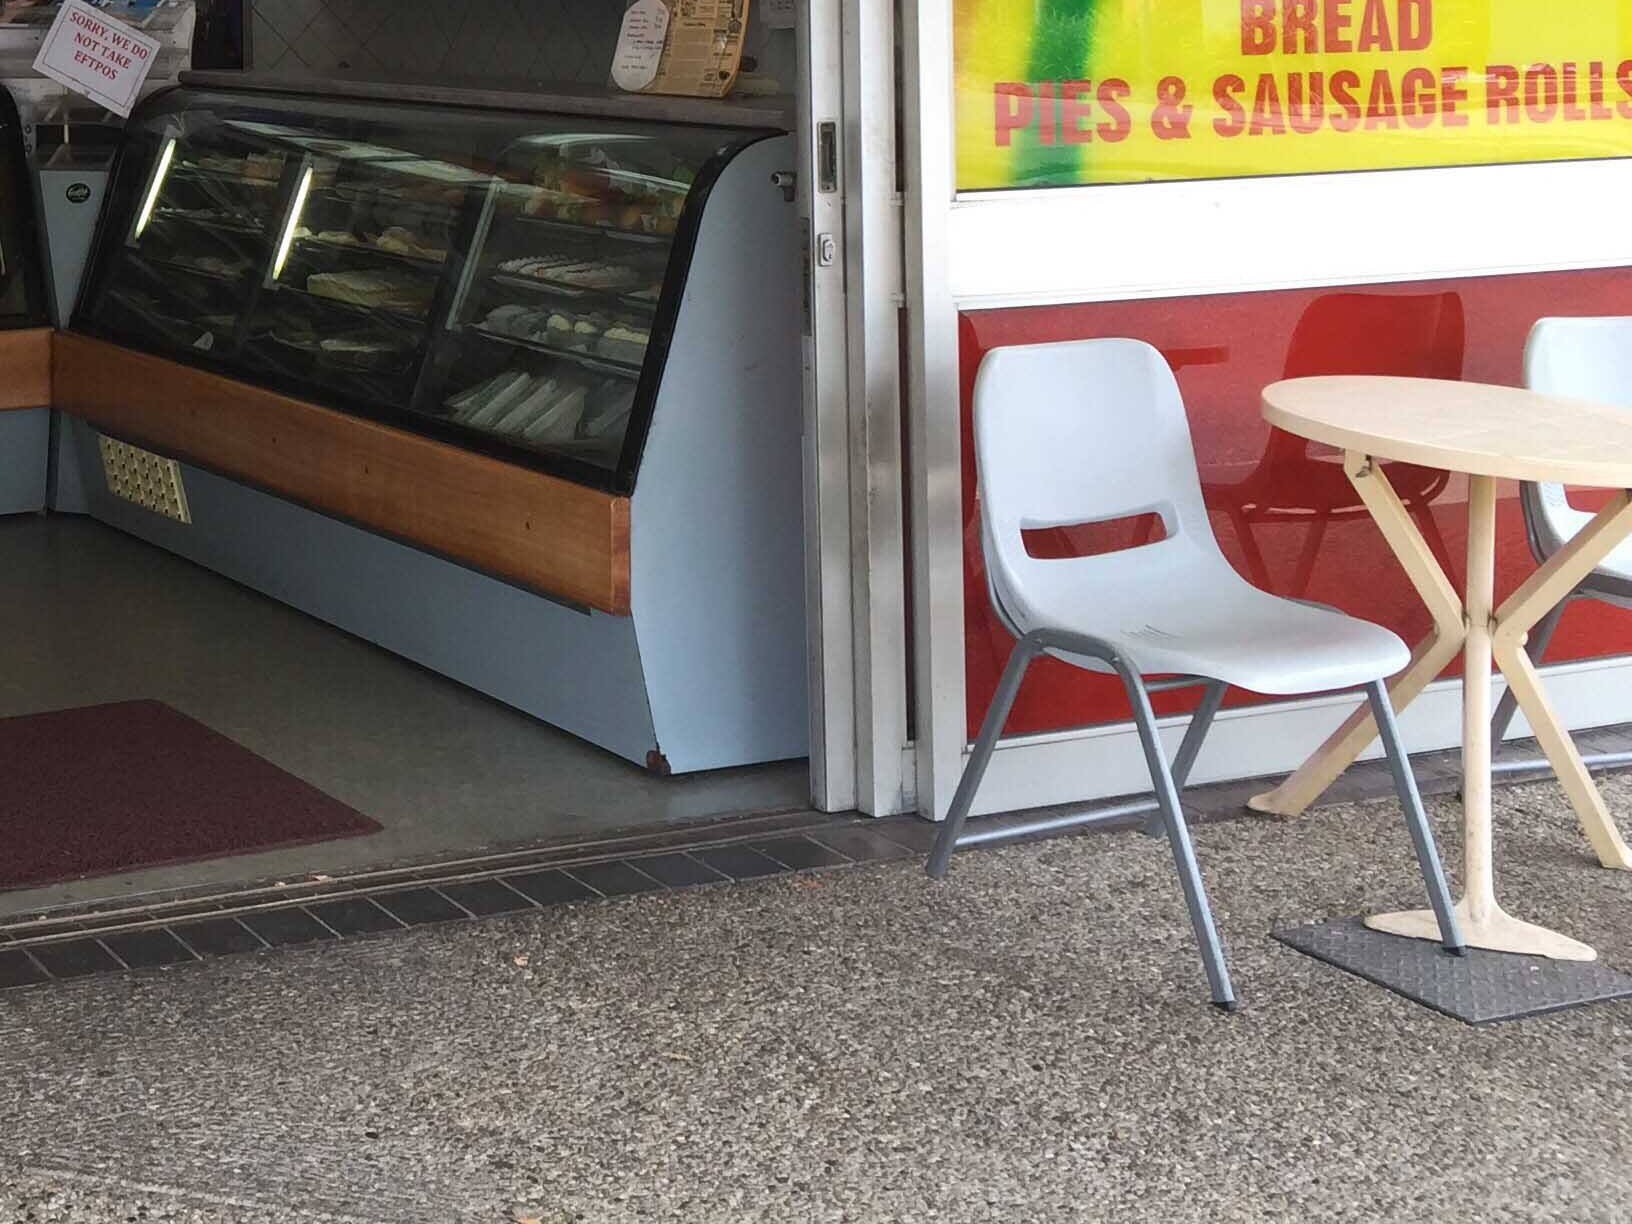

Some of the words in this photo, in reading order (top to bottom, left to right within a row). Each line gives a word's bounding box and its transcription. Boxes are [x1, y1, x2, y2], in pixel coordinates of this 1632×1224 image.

[70, 10, 108, 41] SORRY,
[112, 33, 132, 50] WE
[131, 43, 148, 60] DO
[74, 32, 100, 52] NOT
[102, 45, 132, 69] TAKE
[74, 50, 119, 80] EFTPOS
[994, 77, 1132, 147] PIES
[1151, 71, 1193, 141] &
[1213, 65, 1468, 136] SAUSAGE
